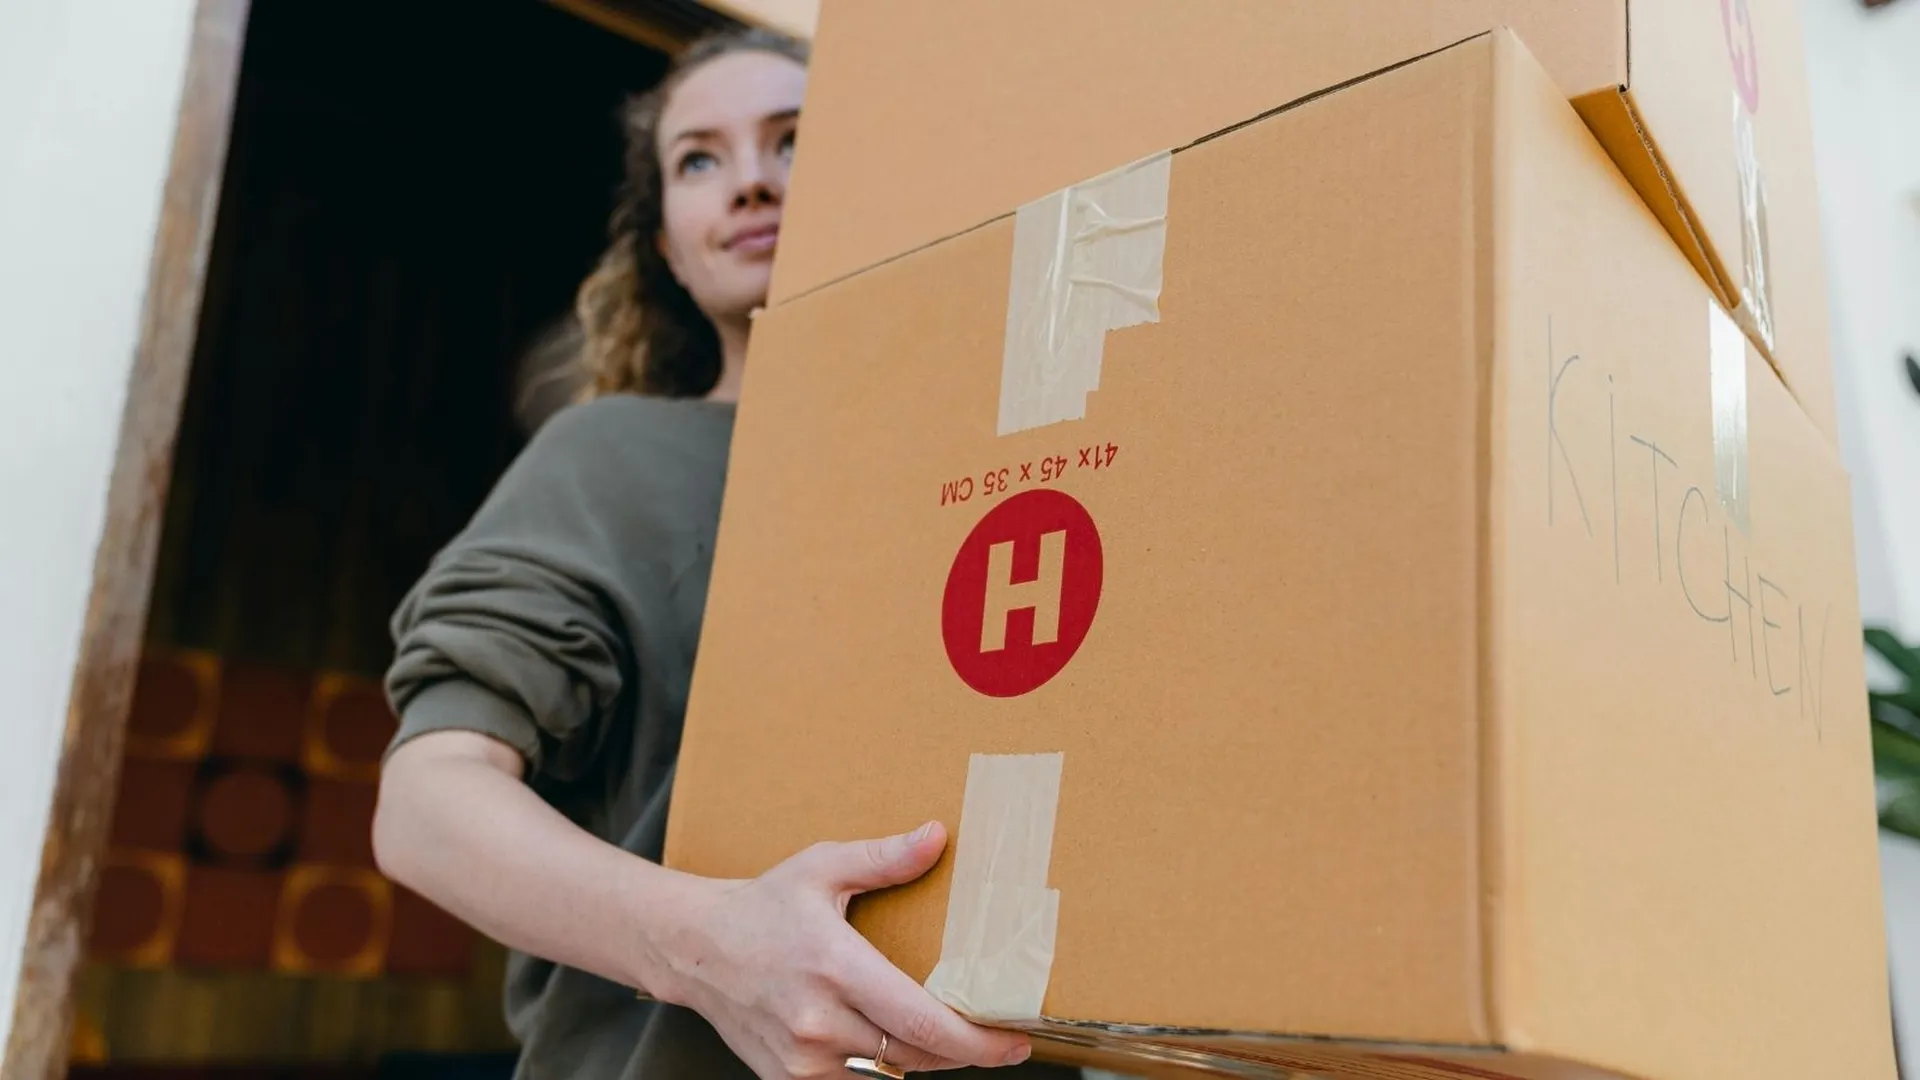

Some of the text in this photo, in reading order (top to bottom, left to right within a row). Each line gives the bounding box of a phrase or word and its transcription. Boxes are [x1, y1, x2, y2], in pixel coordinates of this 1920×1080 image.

[983, 468, 1010, 495] 35
[1019, 462, 1032, 482] x
[1040, 455, 1068, 482] 45
[940, 477, 973, 506] CM
[979, 529, 1067, 653] H
